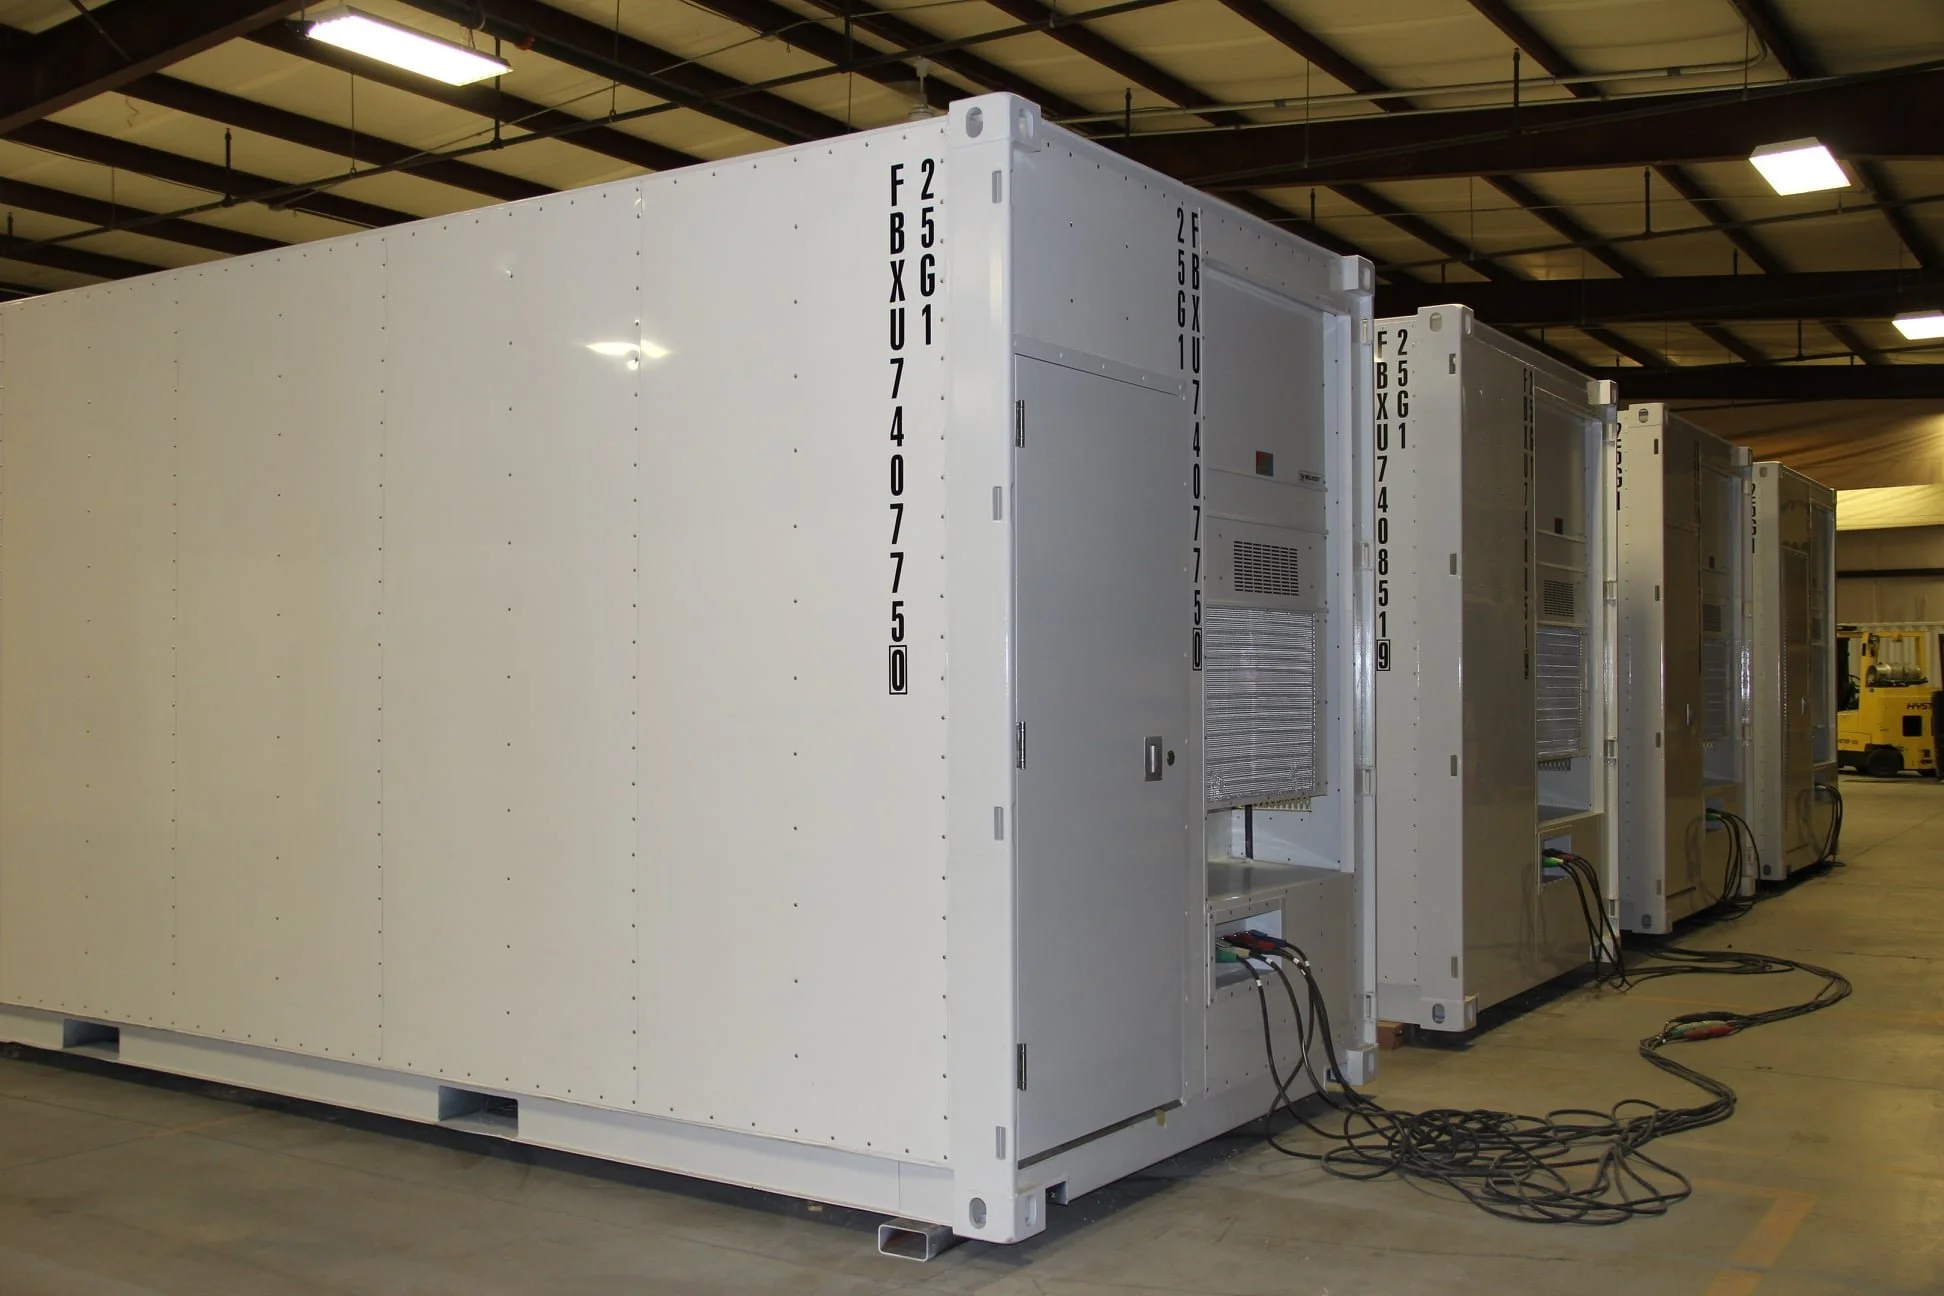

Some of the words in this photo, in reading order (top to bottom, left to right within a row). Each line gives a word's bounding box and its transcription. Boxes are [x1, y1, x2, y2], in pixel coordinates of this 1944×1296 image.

[920, 159, 935, 345] 25G1
[1176, 207, 1186, 370] 25G1
[1397, 329, 1409, 449] 25G1
